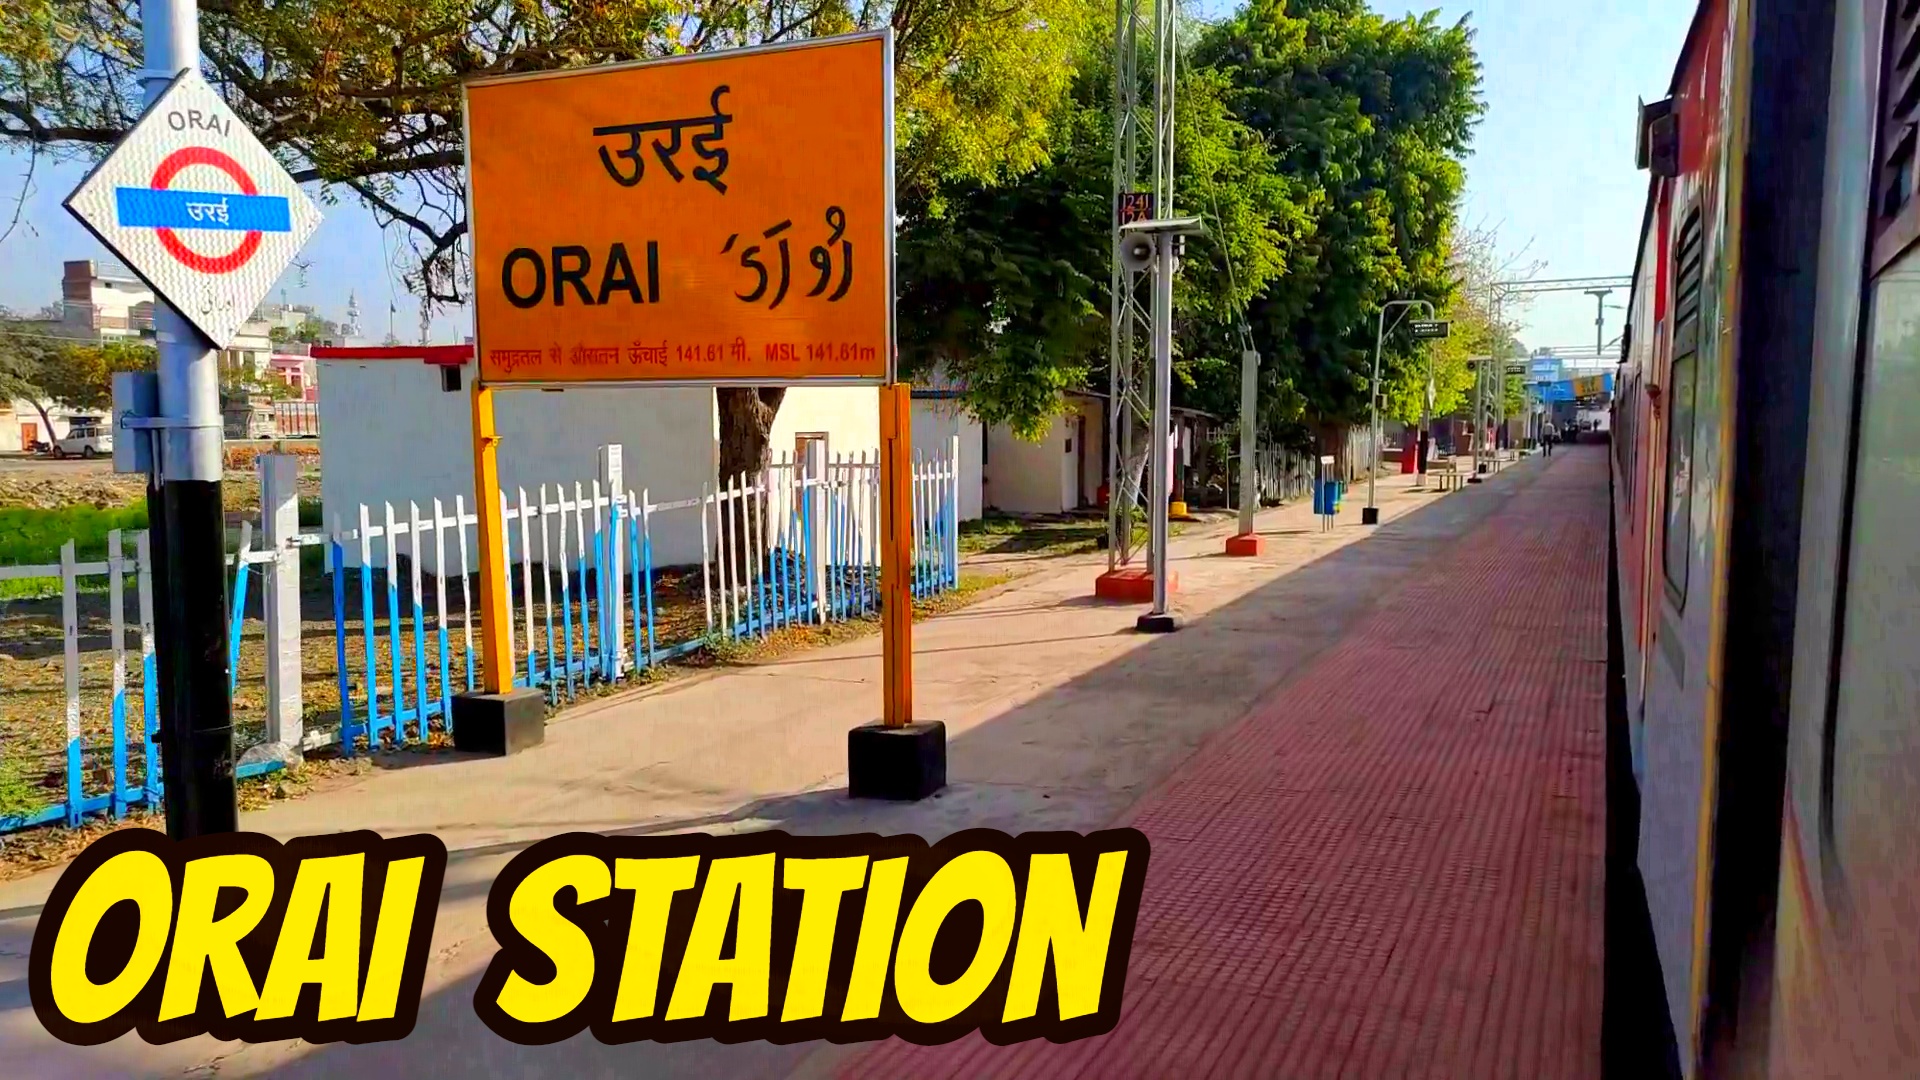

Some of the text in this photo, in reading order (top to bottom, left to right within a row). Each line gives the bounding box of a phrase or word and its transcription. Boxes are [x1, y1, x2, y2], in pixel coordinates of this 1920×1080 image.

[167, 109, 231, 137] ORAI
[593, 85, 733, 196] उरई
[185, 196, 230, 226] उरई
[501, 240, 660, 309] ORAI
[489, 348, 543, 374] समुद्रतल
[549, 341, 563, 365] से
[676, 344, 724, 363] 141.61
[765, 343, 800, 362] MSL
